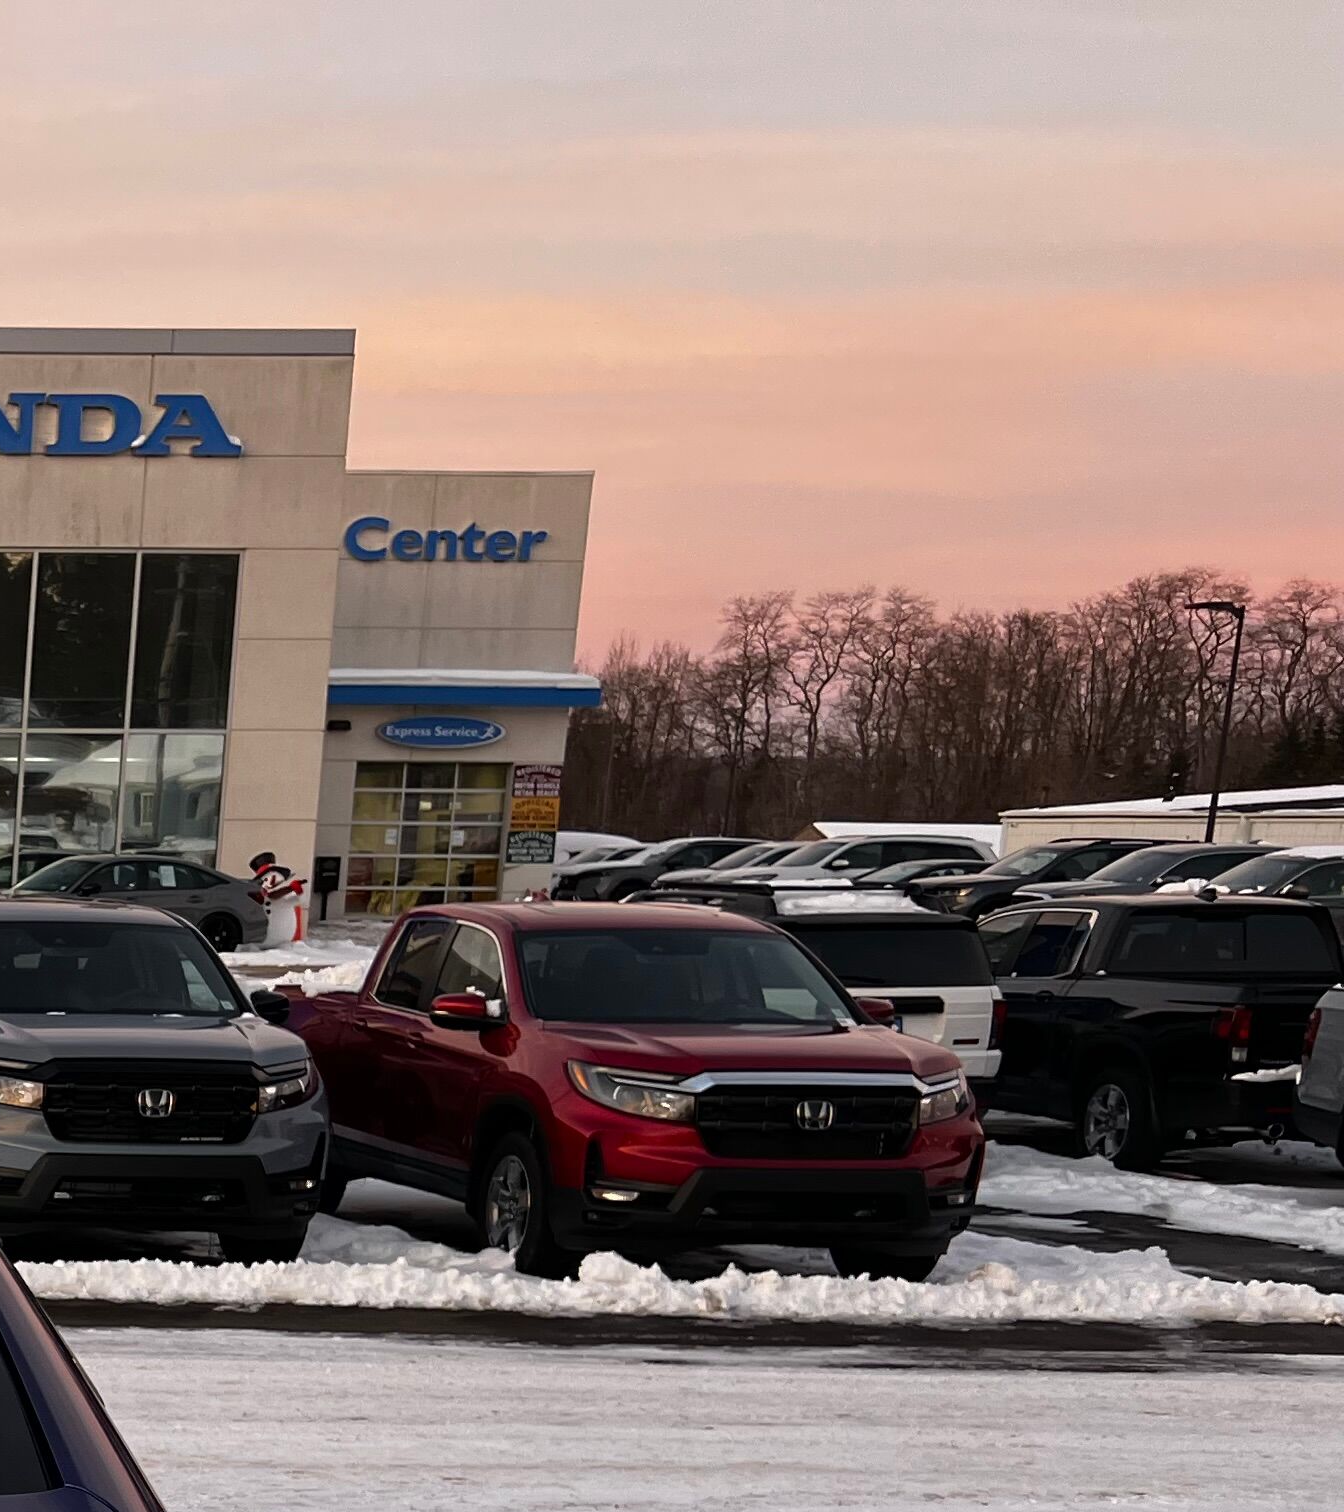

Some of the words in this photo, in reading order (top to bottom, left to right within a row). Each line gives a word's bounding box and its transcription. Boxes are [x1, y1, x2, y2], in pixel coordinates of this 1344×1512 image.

[343, 516, 548, 562] Center
[385, 725, 431, 739] Express
[434, 725, 478, 737] Service
